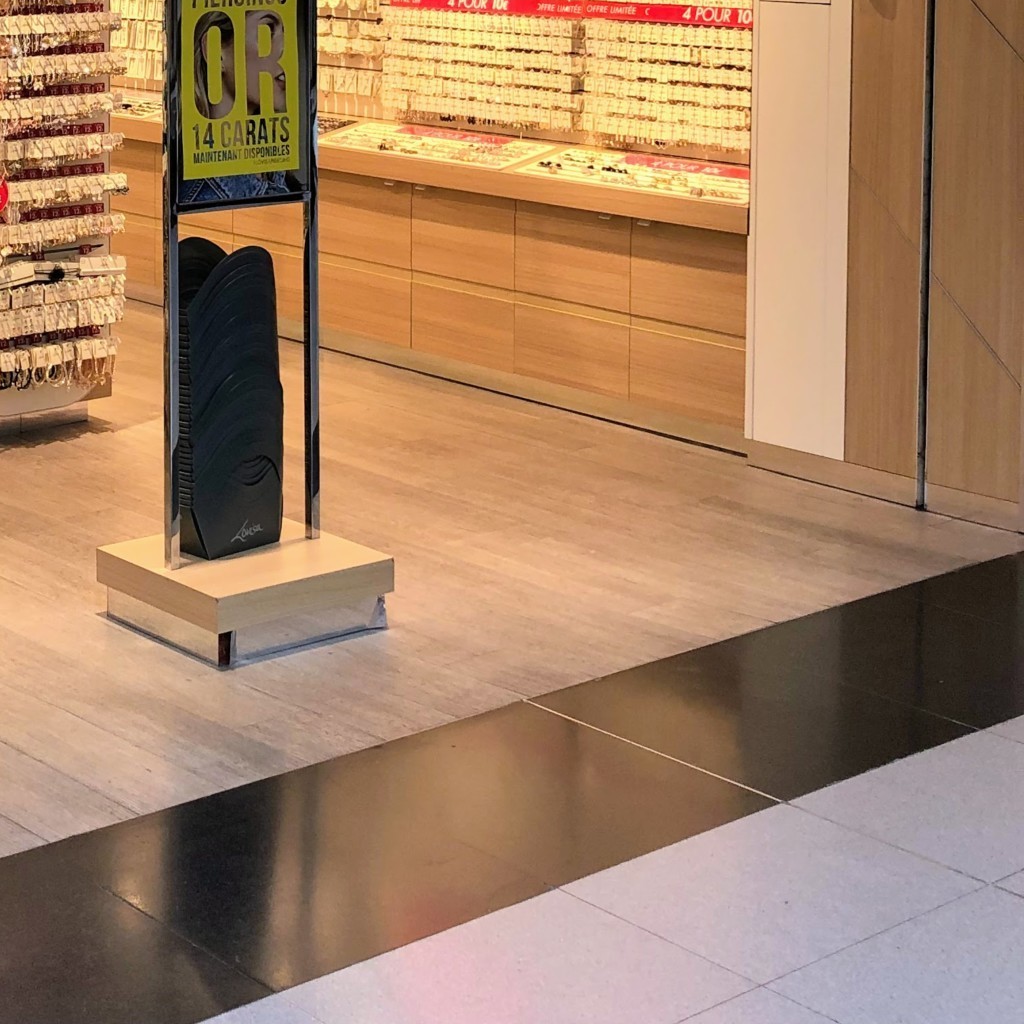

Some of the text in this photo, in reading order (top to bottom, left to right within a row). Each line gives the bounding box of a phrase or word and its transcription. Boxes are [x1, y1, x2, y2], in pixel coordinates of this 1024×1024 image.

[586, 4, 609, 14] OFFRE
[682, 6, 692, 21] 4
[694, 7, 732, 24] POUR
[193, 9, 288, 120] OR
[192, 116, 290, 150] 14 CARATS
[193, 149, 243, 164] MAINTENANT
[243, 144, 290, 160] DISPONIBLES
[230, 519, 264, 543] Lovisa
